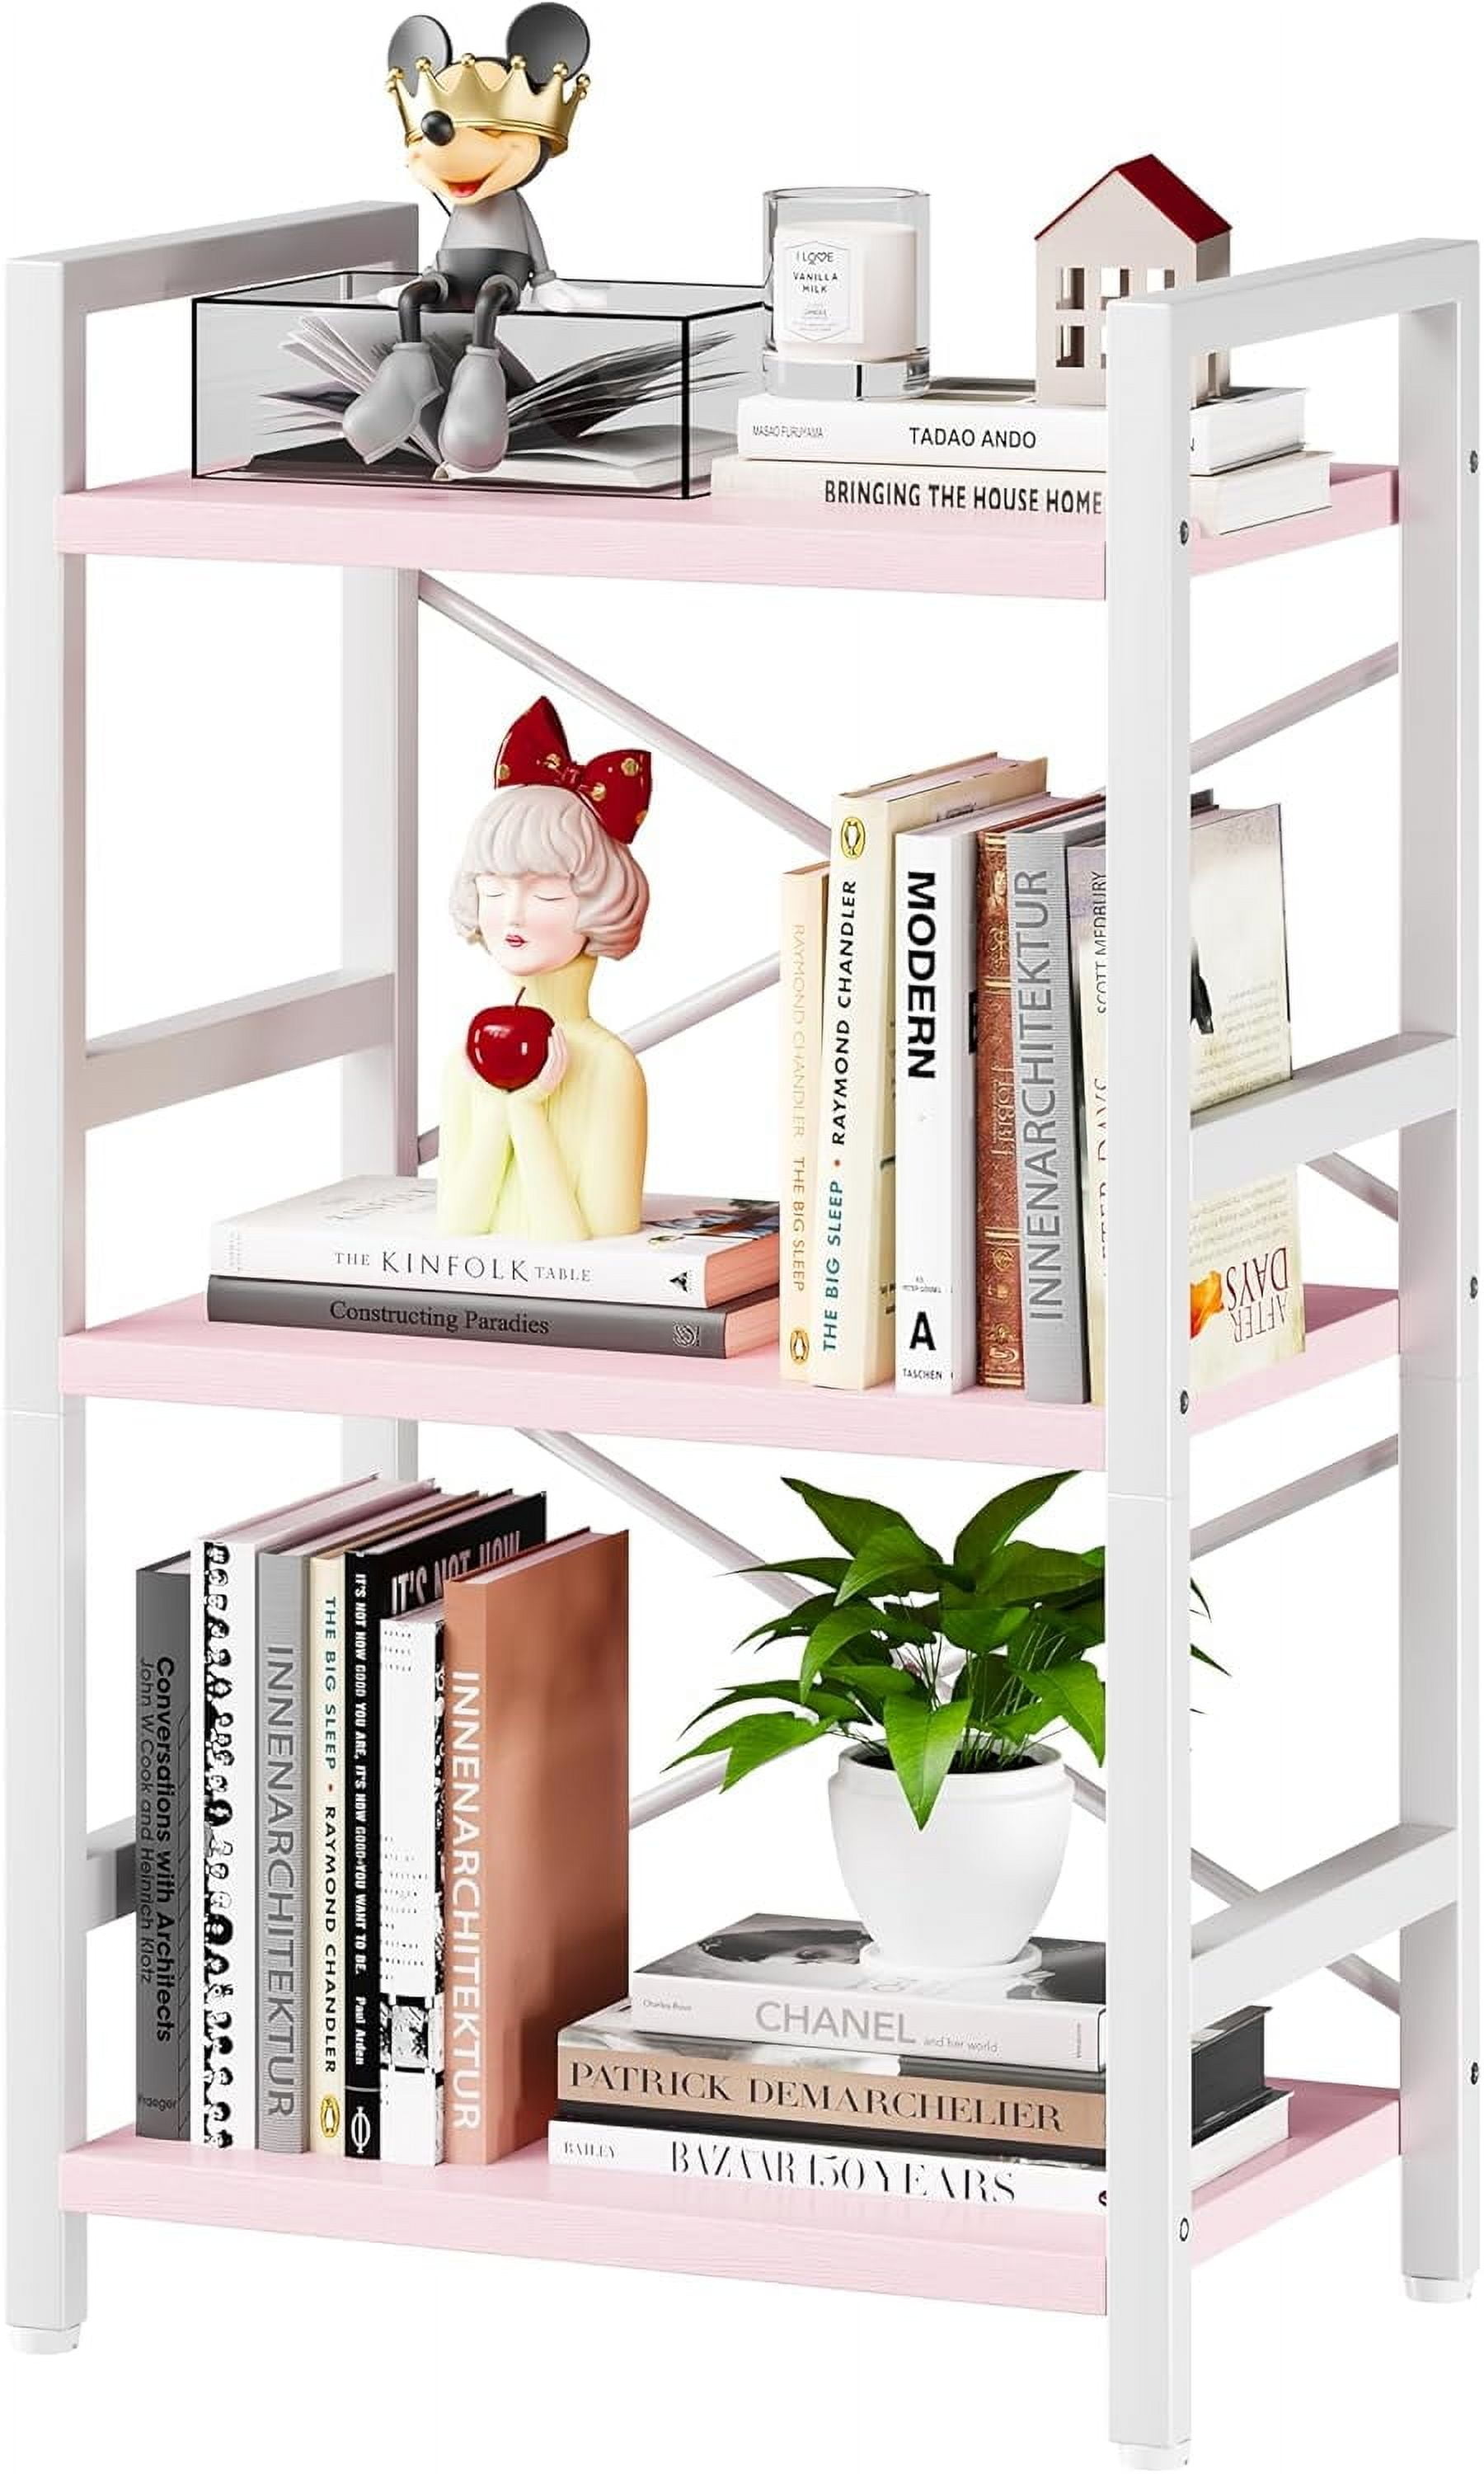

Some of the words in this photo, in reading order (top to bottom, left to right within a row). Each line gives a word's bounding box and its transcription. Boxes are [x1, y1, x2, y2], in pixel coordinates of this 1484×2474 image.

[793, 271, 838, 281] VANILLA
[802, 285, 828, 294] MILK
[909, 427, 975, 447] TADAO
[981, 430, 1036, 449] ANDO
[825, 480, 921, 506] BRINGING
[928, 485, 966, 508] THE
[974, 487, 1040, 512] HOUSE
[1046, 489, 1102, 515] HOME
[838, 880, 856, 1009] CHANDLER
[791, 924, 805, 1021] RAYMOND
[907, 871, 937, 1079] MODERN
[791, 1031, 805, 1137] CHANDLER
[832, 1019, 851, 1145] RAYMOND
[1014, 870, 1064, 1319] INNENARCHITEKTUR
[792, 1158, 805, 1194] THE
[792, 1201, 805, 1231] BIG
[828, 1180, 843, 1246] SLEEP
[335, 1253, 370, 1266] THE
[383, 1251, 528, 1282] KINFOLK
[534, 1266, 591, 1282] TABLE
[792, 1239, 805, 1291] SLEEP
[825, 1258, 840, 1298] BIG
[1226, 1247, 1289, 1311] DAYS
[330, 1300, 459, 1332] Constructing
[465, 1310, 549, 1334] Paradies
[823, 1310, 838, 1352] THE
[909, 1311, 937, 1351] A
[1228, 1292, 1287, 1343] AFTER
[903, 1367, 942, 1380] TASCHEN
[355, 1573, 367, 1597] IT'S
[325, 1597, 336, 1639] THE
[355, 1602, 367, 1627] NOT
[355, 1631, 367, 1660] HOW
[140, 1657, 154, 1706] John
[325, 1651, 336, 1691] BIG
[355, 1702, 367, 1727] YOU
[157, 1657, 175, 1842] Conversations
[325, 1704, 336, 1770] SLEEP
[140, 1739, 154, 1793] Cook
[355, 1765, 367, 1789] IT'S
[140, 1799, 154, 1841] and
[355, 1793, 367, 1822] HOW
[140, 1847, 154, 1930] Heinrich
[157, 1851, 175, 1903] with
[266, 1646, 294, 2116] INNENARCHITEKTUR
[325, 1807, 336, 1932] RAYMOND
[355, 1893, 367, 1929] WANT
[452, 1671, 480, 2128] INNENARCHITEKTUR
[140, 1938, 154, 1985] Klotz
[355, 1934, 367, 1950] TO
[157, 1912, 175, 2042] Architects
[325, 1944, 336, 2072] CHANDLER
[355, 1996, 367, 2024] Paul
[755, 2001, 916, 2044] CHANEL
[923, 2036, 944, 2046] and
[946, 2038, 965, 2048] her
[967, 2039, 998, 2053] world
[355, 2029, 367, 2065] Arden
[569, 2062, 733, 2100] PATRICK
[749, 2078, 1064, 2132] DEMARCHELIER
[565, 2141, 615, 2158] BAILEY
[672, 2141, 795, 2183] BAZAAR
[810, 2154, 866, 2190] 150
[876, 2160, 1015, 2203] YEARS
